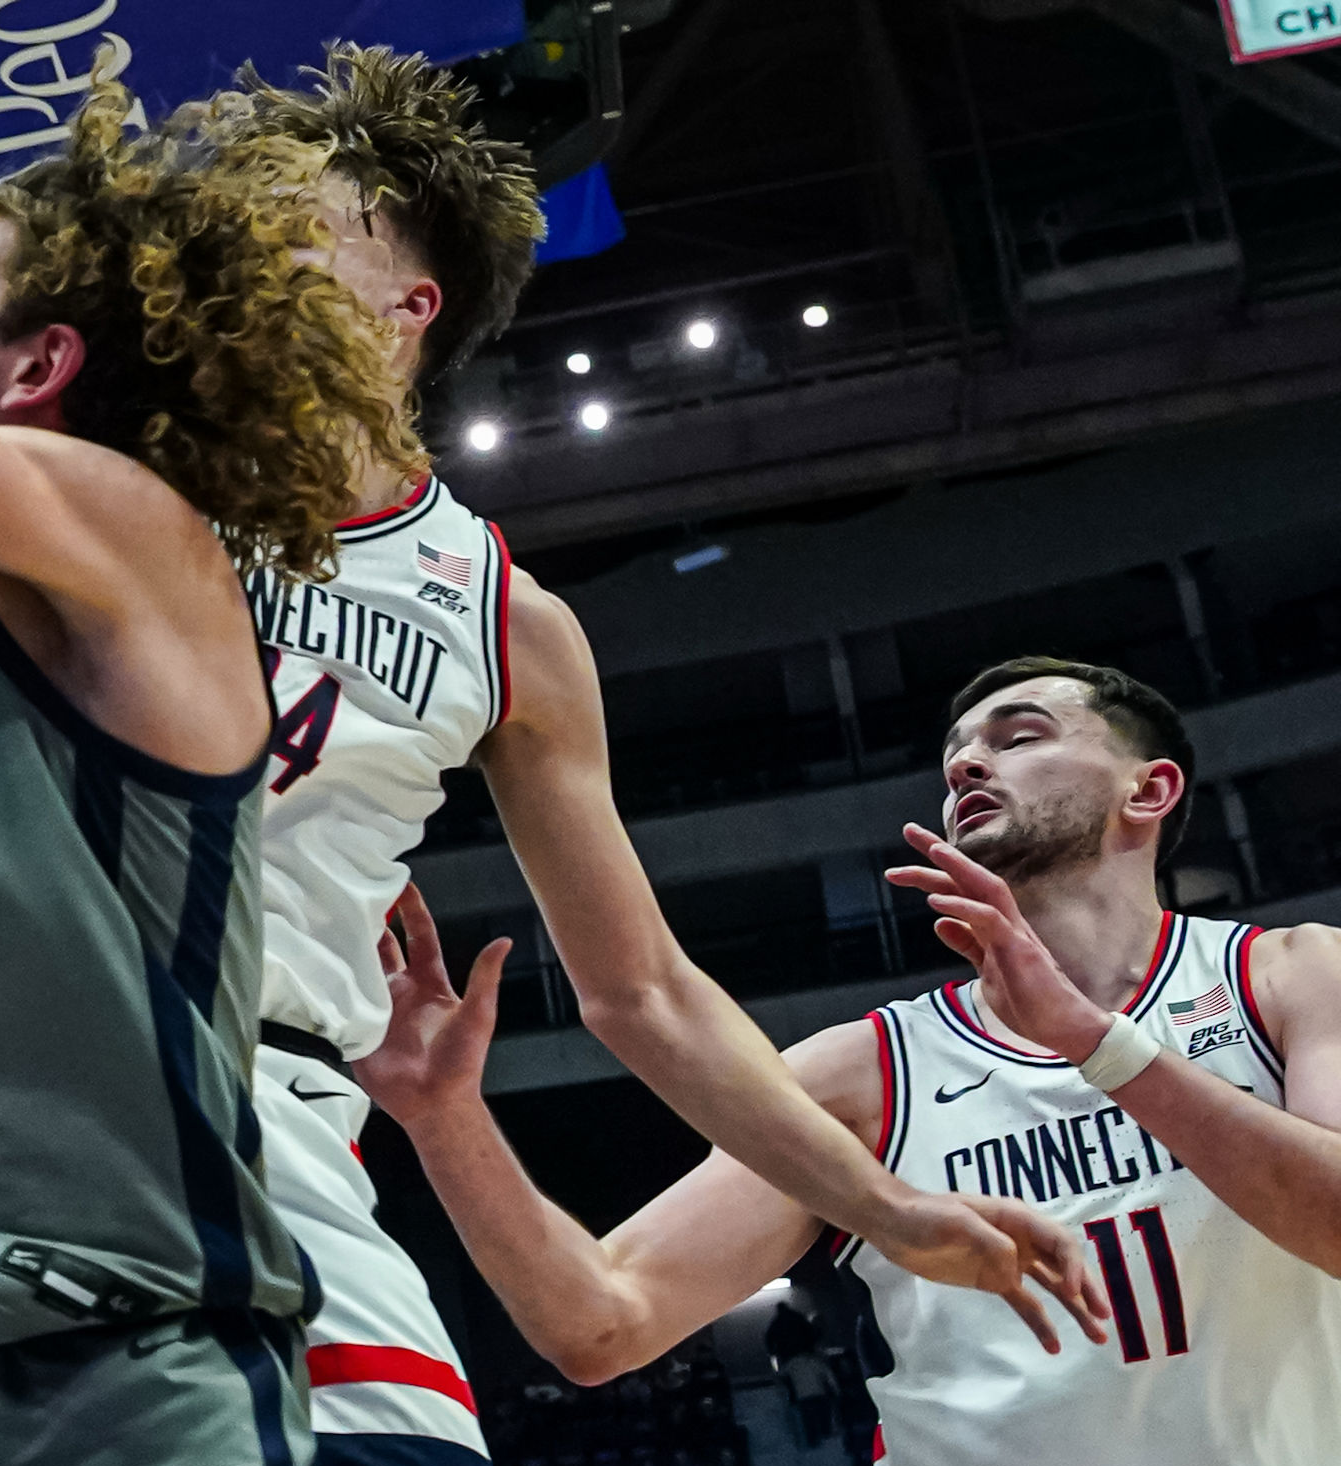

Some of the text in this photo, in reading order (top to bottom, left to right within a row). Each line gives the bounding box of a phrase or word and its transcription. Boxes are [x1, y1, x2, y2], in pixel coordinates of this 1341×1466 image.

[419, 582, 463, 600] BIG
[417, 592, 470, 615] EAST
[1188, 1027, 1246, 1055] EAST
[1190, 1021, 1231, 1042] BIG
[1084, 1206, 1189, 1363] 11
